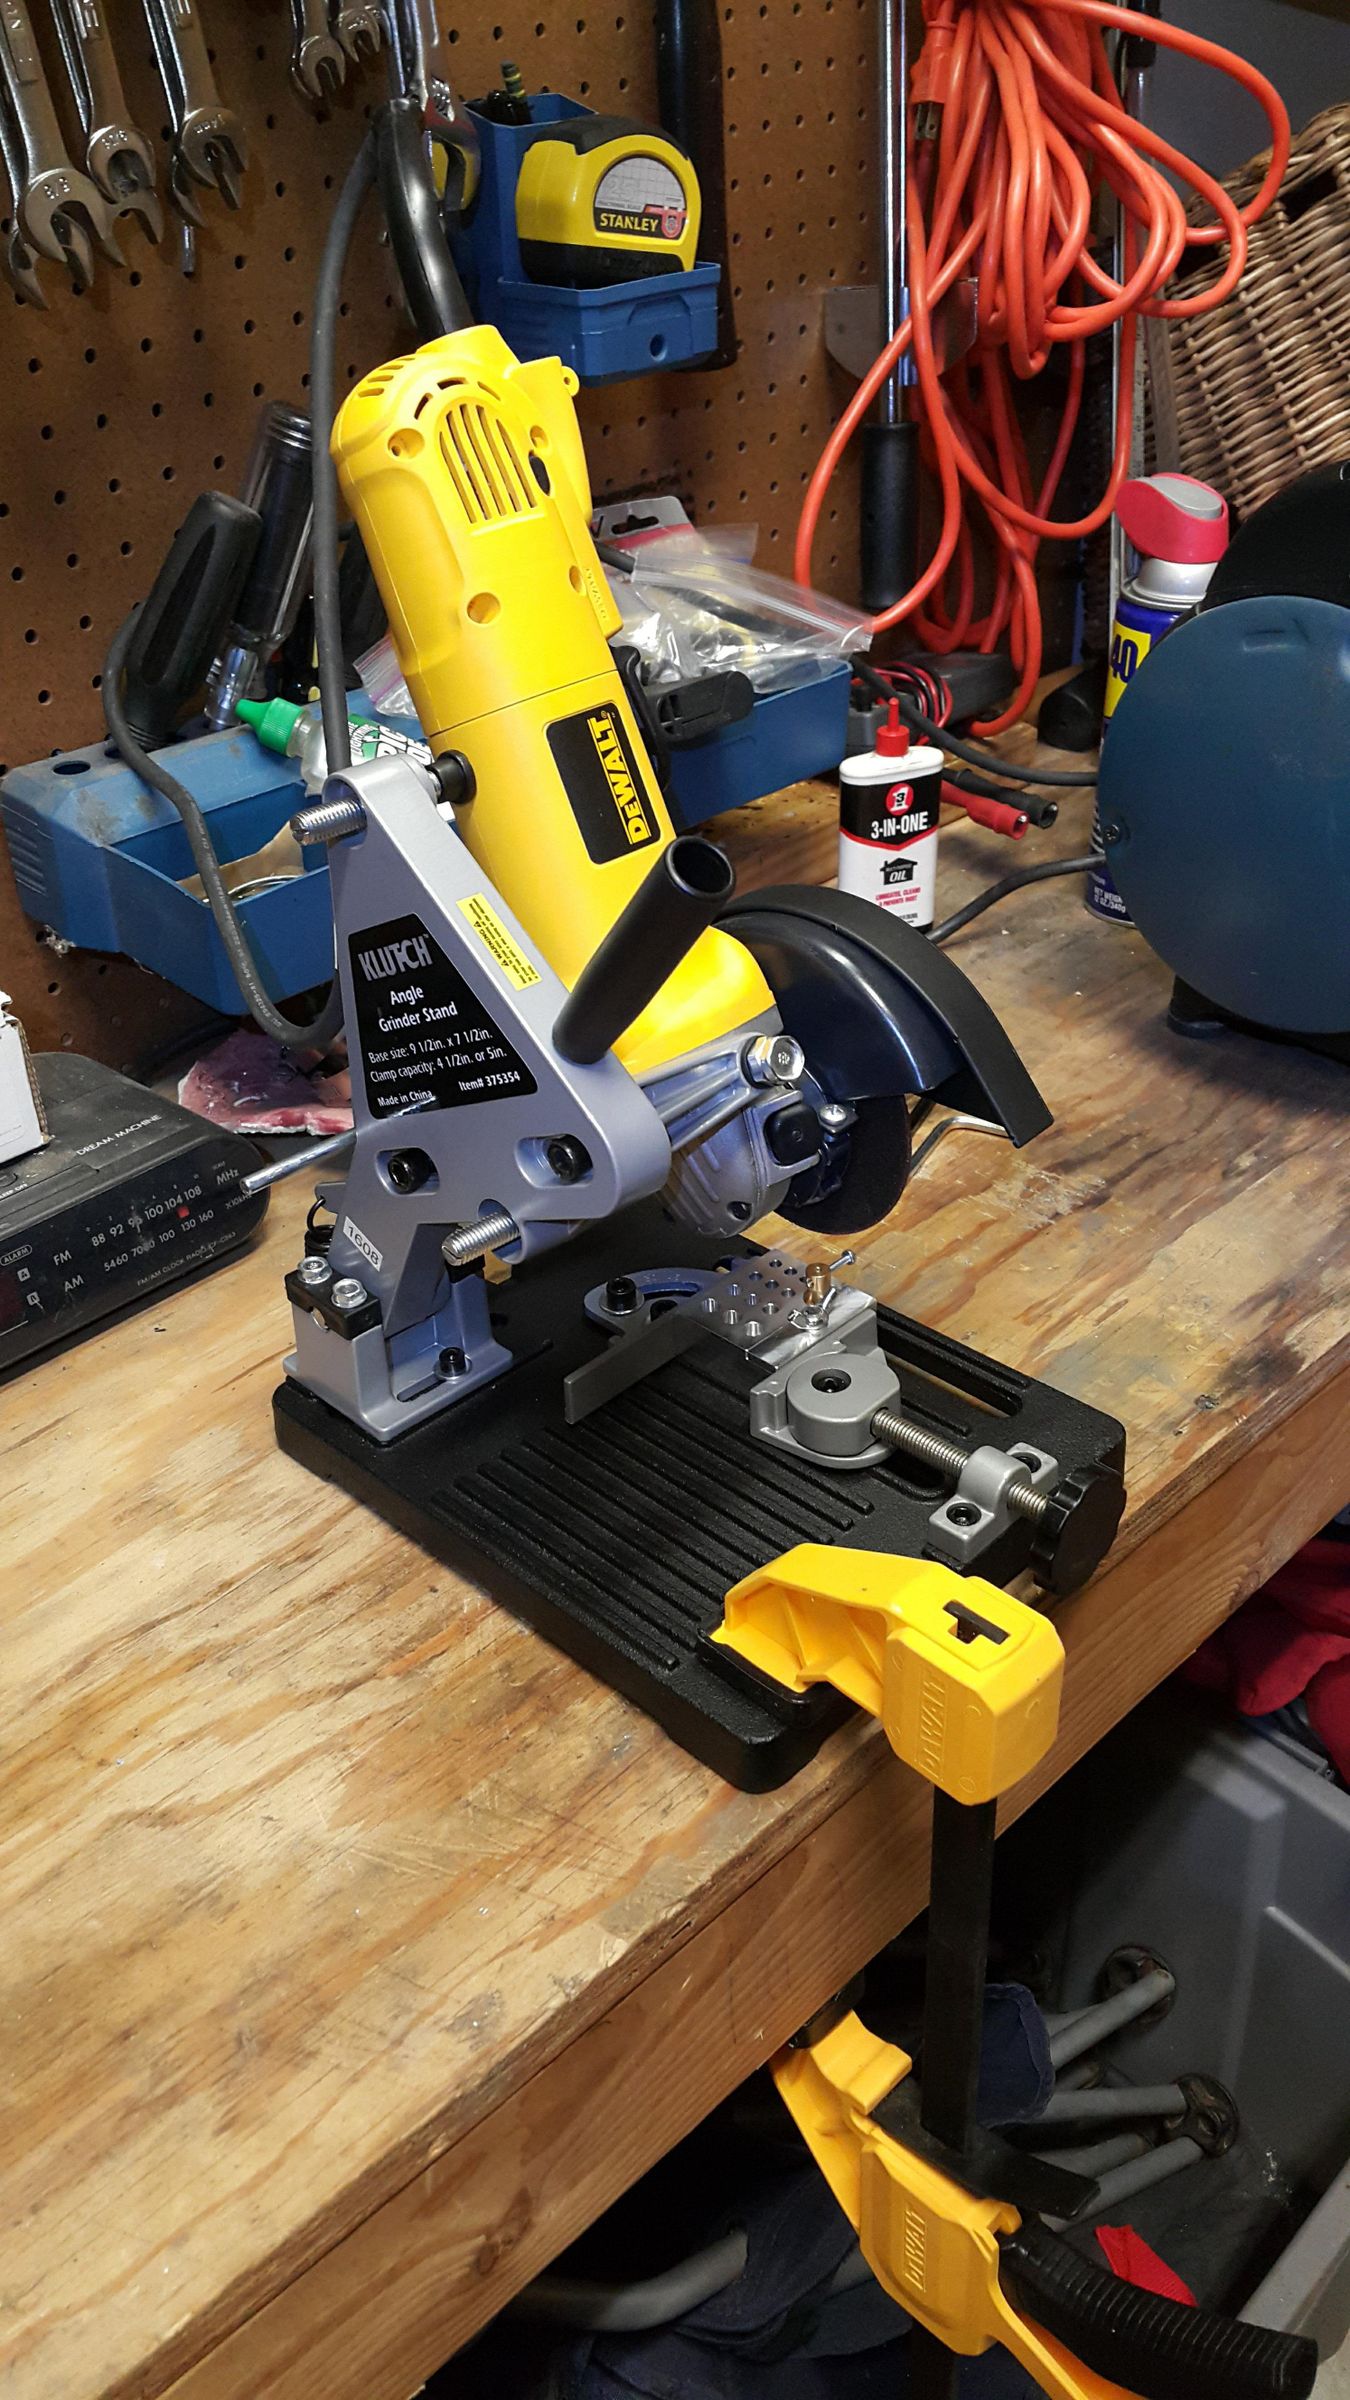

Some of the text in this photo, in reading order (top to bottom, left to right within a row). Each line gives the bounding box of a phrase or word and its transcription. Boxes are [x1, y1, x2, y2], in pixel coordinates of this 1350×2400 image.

[600, 213, 659, 232] STANLEY
[376, 725, 408, 758] PIC
[587, 714, 652, 845] DEWALT
[870, 811, 929, 839] 3-IN-ONE
[889, 870, 907, 882] OIL
[358, 936, 433, 981] KLUTCH
[478, 929, 503, 960] WARNING
[389, 985, 425, 1006] Angle
[378, 1001, 459, 1032] Grinder Stand
[368, 1028, 494, 1064] Base size: 9 1/2in. x 7 1/2in.
[370, 1046, 508, 1083] Clamp capacity: 4 1/2in. or 5in.
[458, 1071, 521, 1091] Item# 375354
[377, 1089, 434, 1107] Made in China
[76, 1114, 162, 1156] DREAM MACHINE
[216, 1168, 240, 1185] MHz
[53, 1250, 72, 1266] FM
[91, 1233, 106, 1247] 88
[109, 1224, 125, 1238] 92
[144, 1204, 165, 1220] 100
[164, 1194, 183, 1211] 104
[184, 1185, 202, 1201] 108
[4, 1247, 29, 1264] ALARM
[63, 1274, 85, 1293] AM
[158, 1230, 176, 1243] 100
[180, 1218, 196, 1232] 130
[198, 1209, 214, 1223] 160
[348, 1226, 379, 1265] 1608
